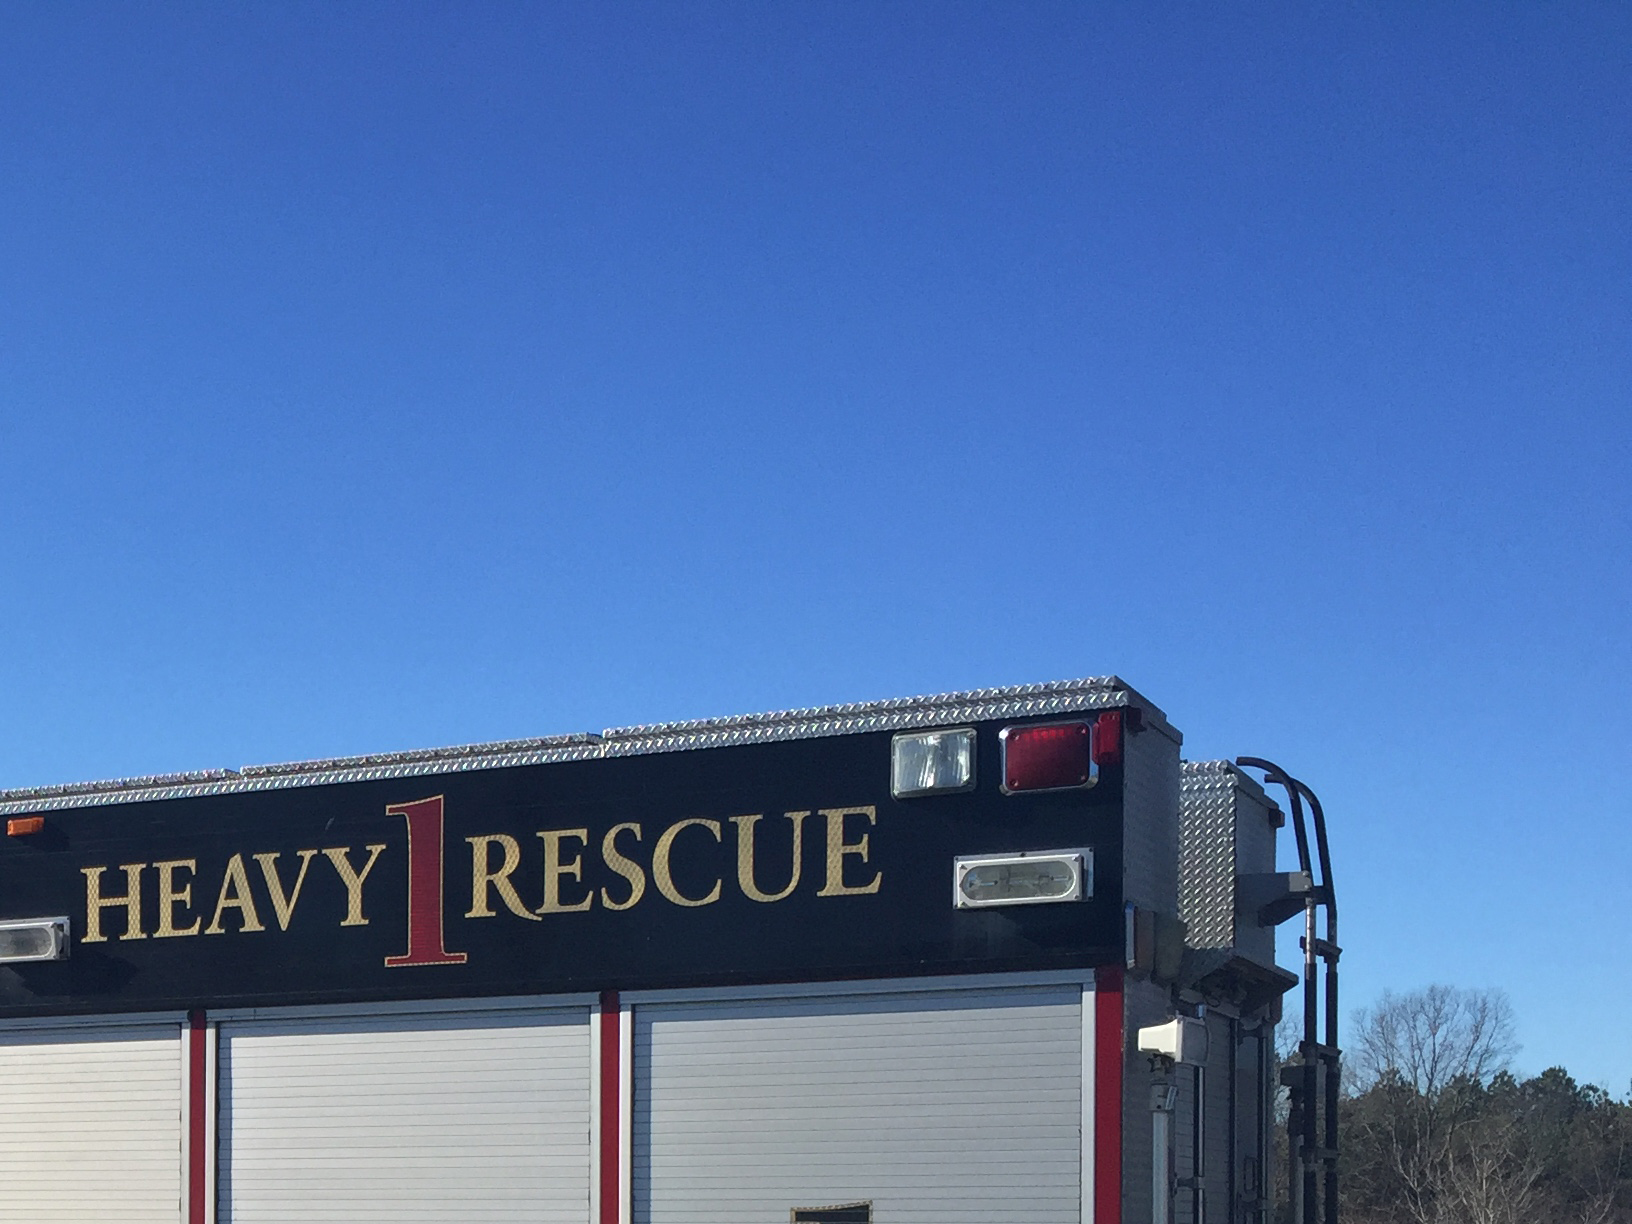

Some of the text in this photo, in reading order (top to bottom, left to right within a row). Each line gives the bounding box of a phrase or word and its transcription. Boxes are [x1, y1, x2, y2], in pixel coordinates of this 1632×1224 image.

[81, 794, 883, 968] HEAVY 1 RESCUE
